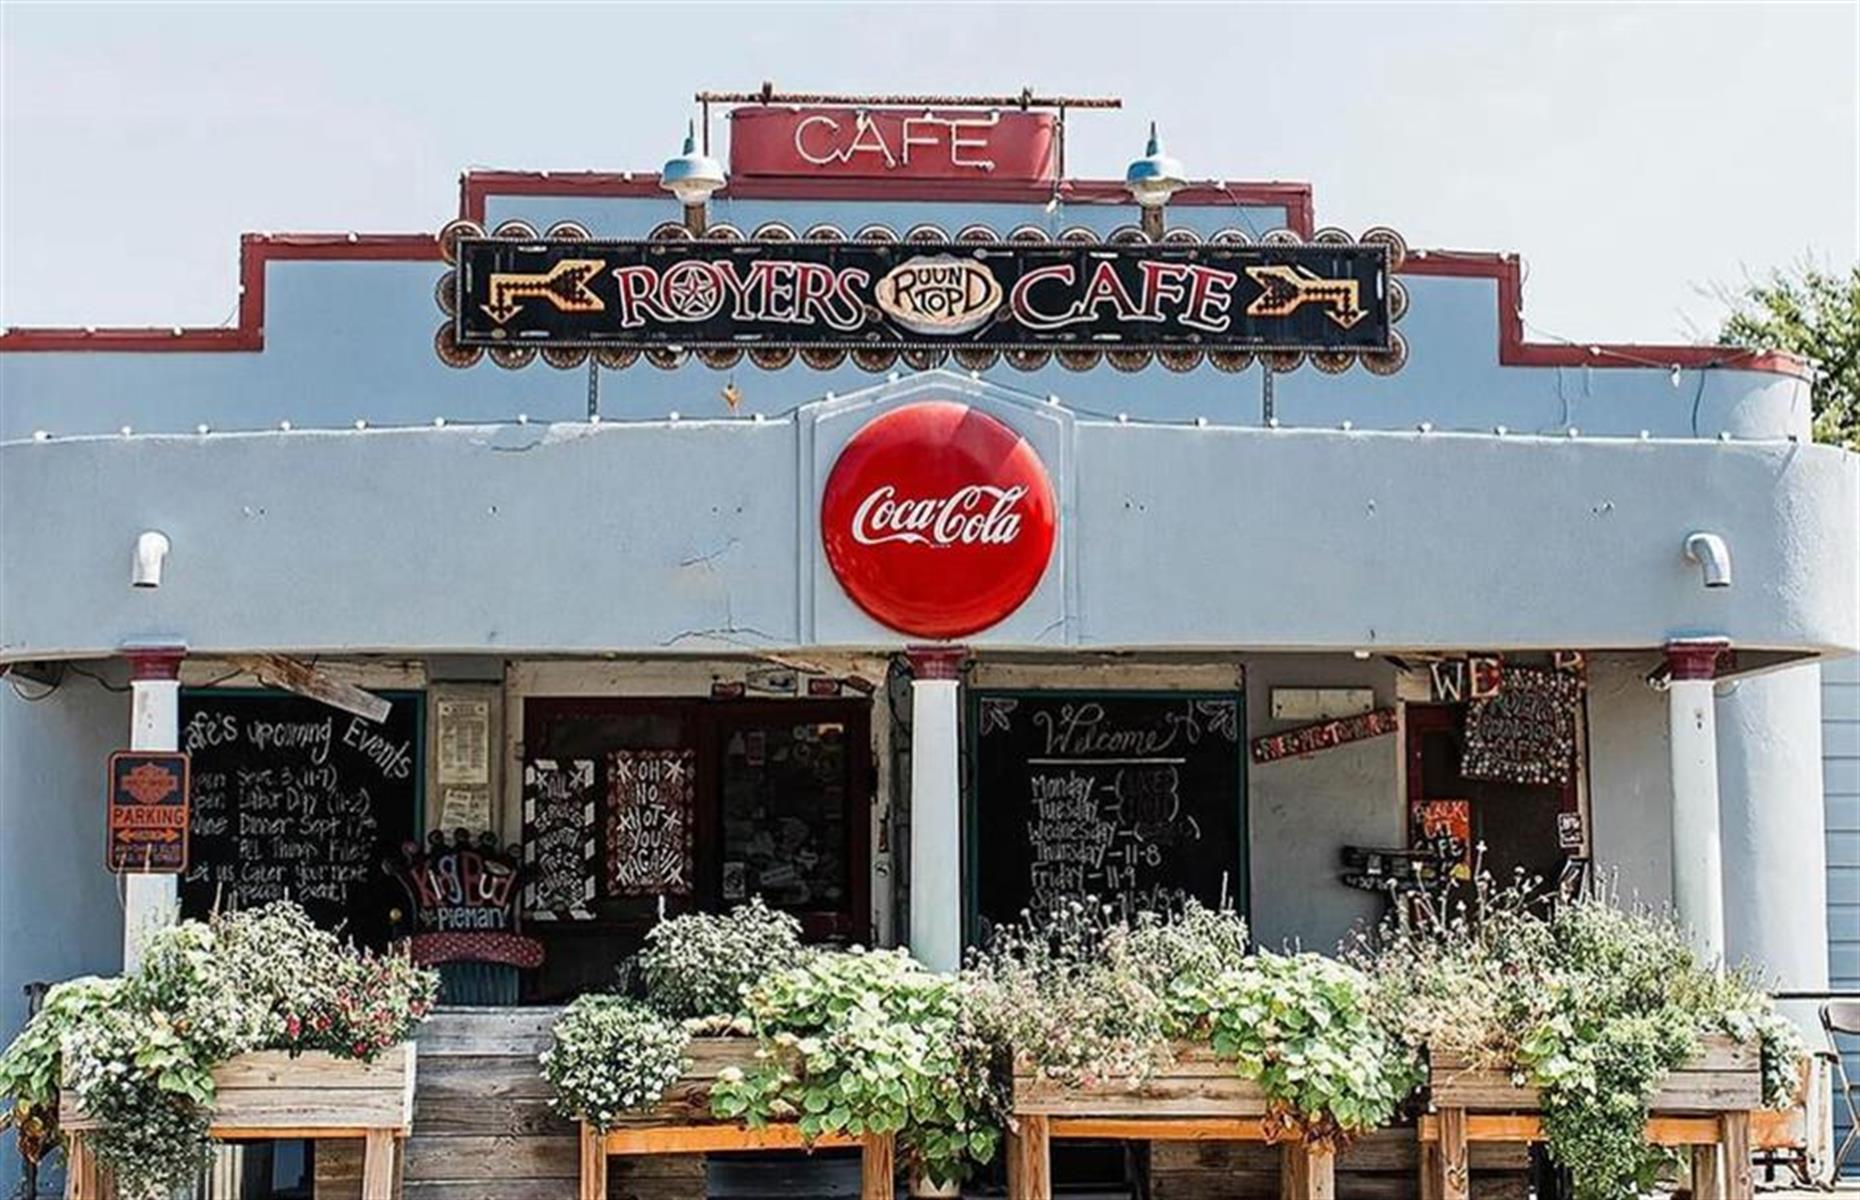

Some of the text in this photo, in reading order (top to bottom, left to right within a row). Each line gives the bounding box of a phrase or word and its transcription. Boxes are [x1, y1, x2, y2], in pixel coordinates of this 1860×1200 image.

[795, 113, 998, 169] CAFE
[612, 259, 871, 332] ROYERS
[1009, 260, 1238, 333] CAFE
[851, 484, 1030, 546] Coca-Cola
[1032, 703, 1178, 754] Welcome
[187, 710, 239, 757] afe's
[342, 716, 413, 780] Events
[638, 760, 660, 782] OH
[1031, 769, 1095, 801] Monday
[636, 783, 658, 806] NO
[113, 807, 185, 826] PARKING
[1031, 798, 1099, 824] Tuesday
[629, 829, 662, 854] YOU
[1027, 820, 1118, 847] Wednesday
[1031, 841, 1106, 869] Thursday
[1030, 862, 1085, 891] Friday
